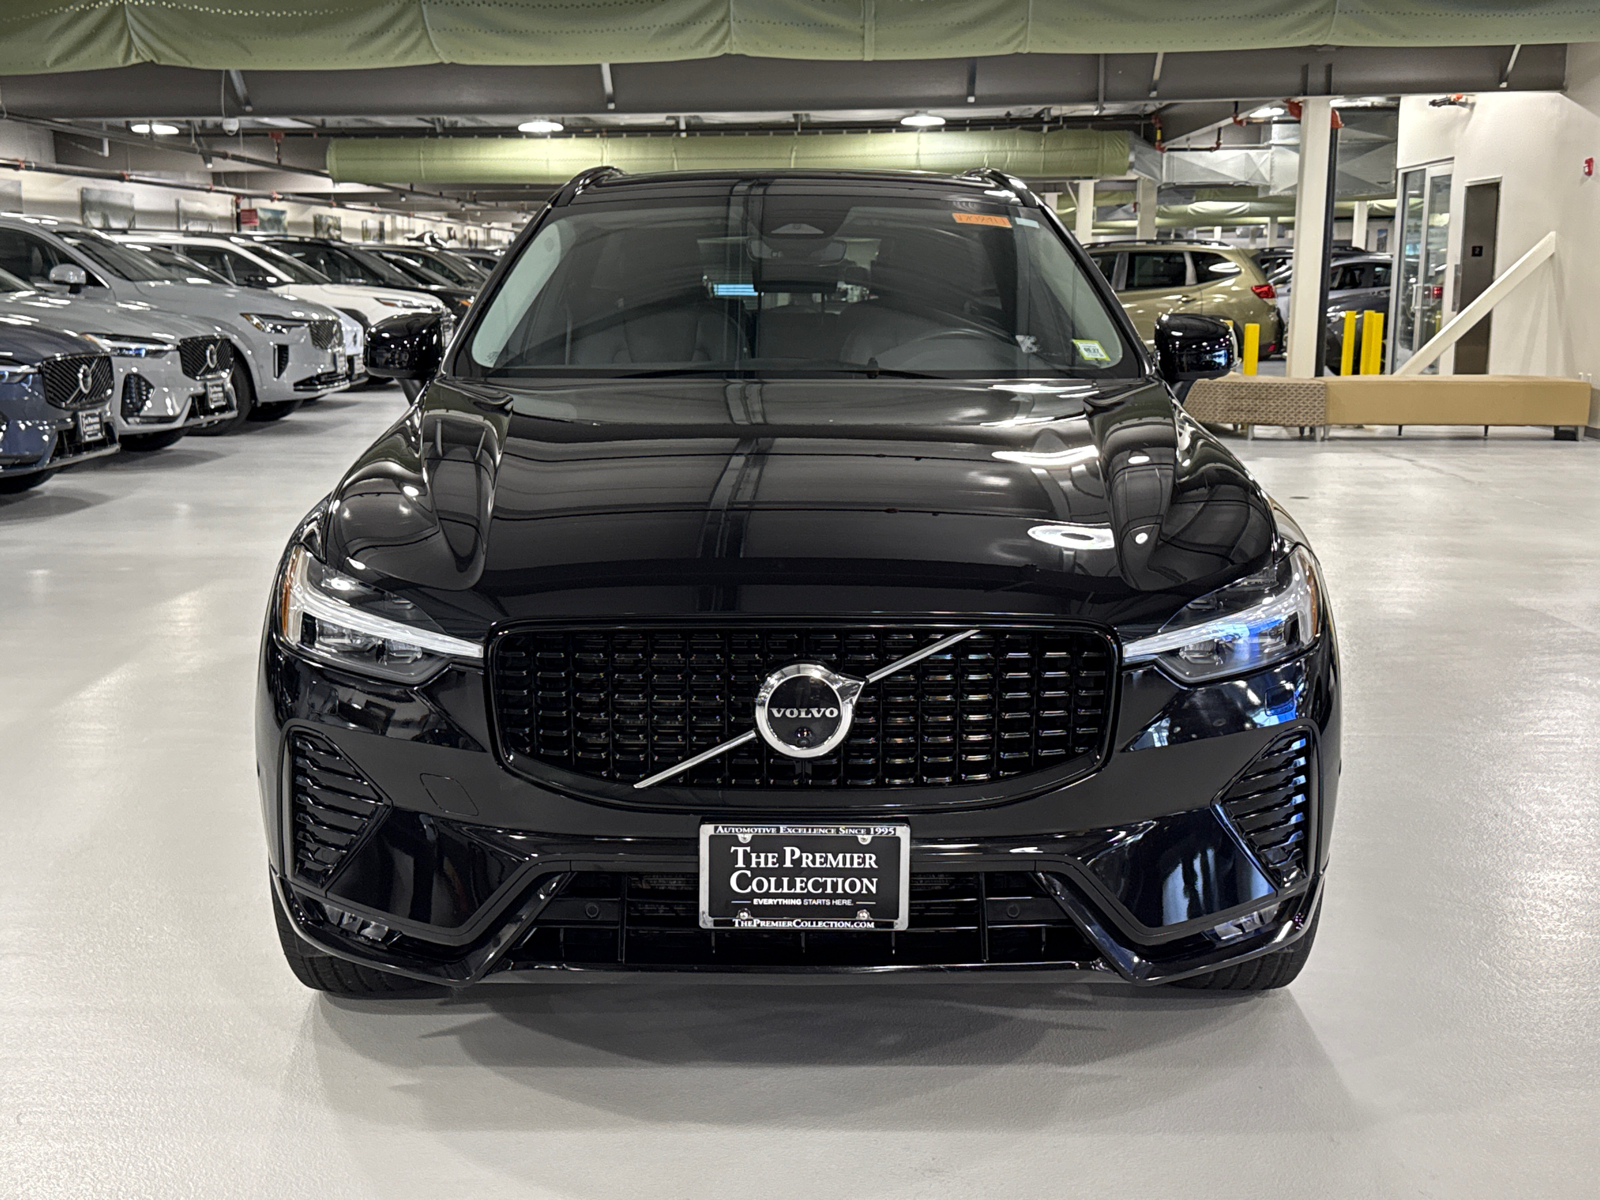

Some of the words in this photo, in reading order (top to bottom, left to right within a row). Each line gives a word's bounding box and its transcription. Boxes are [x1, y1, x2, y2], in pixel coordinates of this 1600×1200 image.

[770, 707, 838, 718] VOLVO
[716, 825, 777, 834] AUTOMOTIVE
[779, 826, 836, 835] EXCELLENCE
[838, 826, 867, 836] SINCE
[869, 827, 895, 836] 1995
[730, 846, 779, 868] THE
[783, 846, 878, 869] PREMIER
[729, 870, 878, 895] COLLECTION
[753, 898, 802, 906] EVERYTHING
